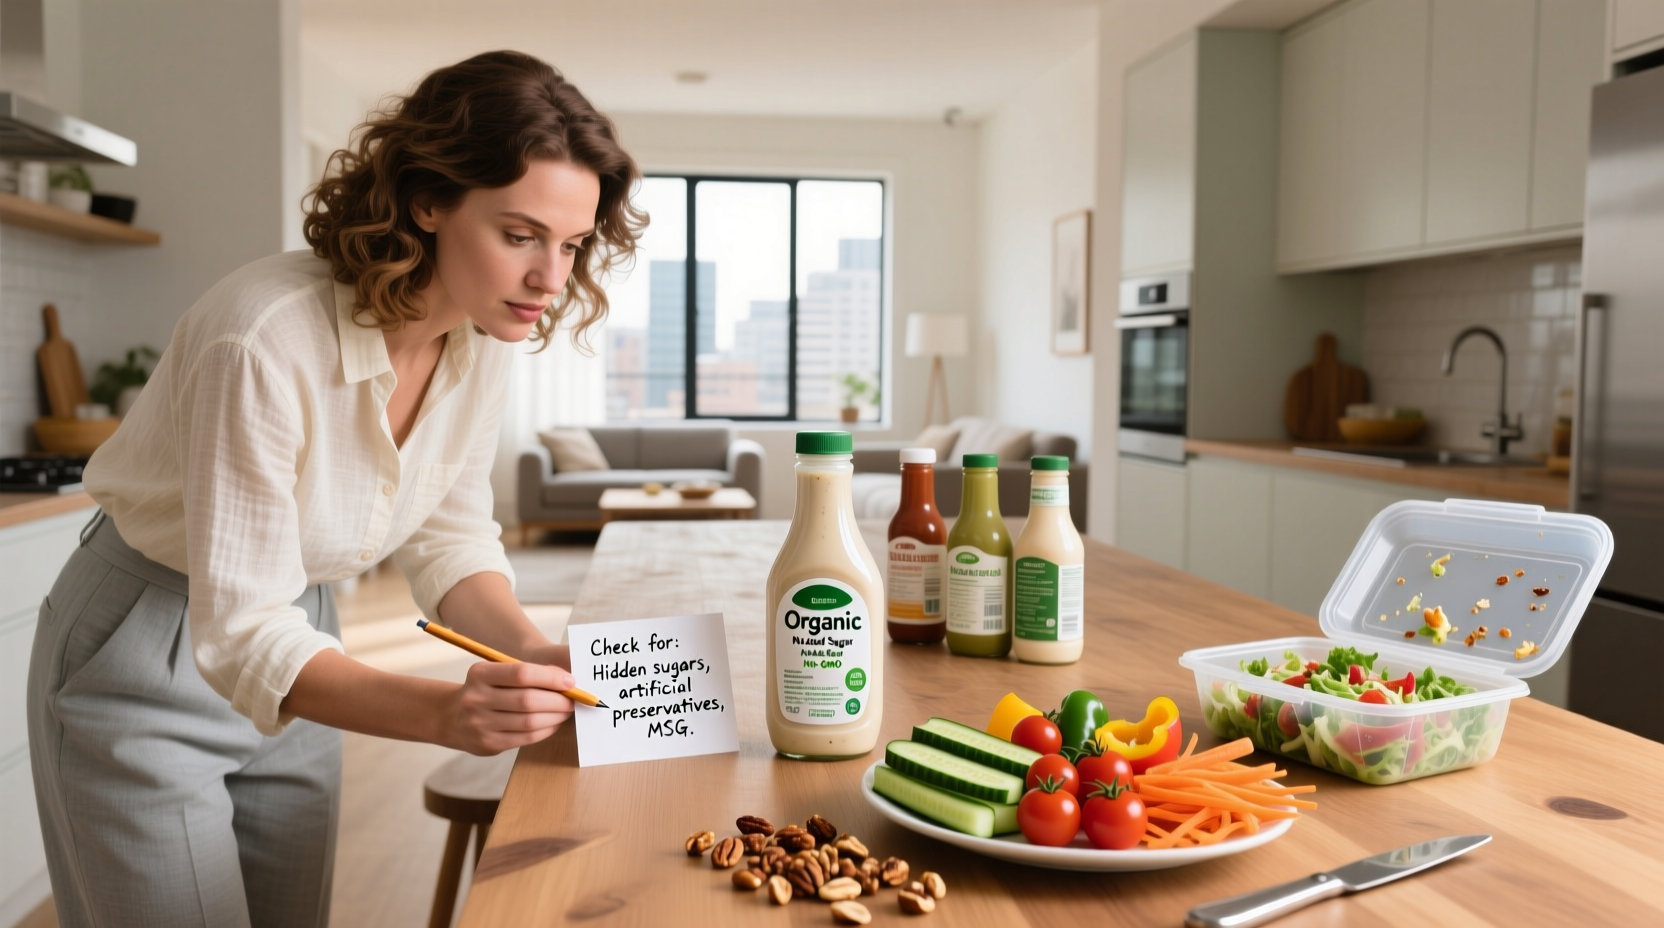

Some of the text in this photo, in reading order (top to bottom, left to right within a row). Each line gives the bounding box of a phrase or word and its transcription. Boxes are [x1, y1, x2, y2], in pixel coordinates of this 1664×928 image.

[784, 610, 862, 635] Organic
[590, 633, 679, 656] Check for:
[593, 658, 710, 681] Hidden sugars,
[619, 677, 692, 699] artificial
[613, 698, 724, 728] preservatives,
[648, 719, 694, 738] MSG.
